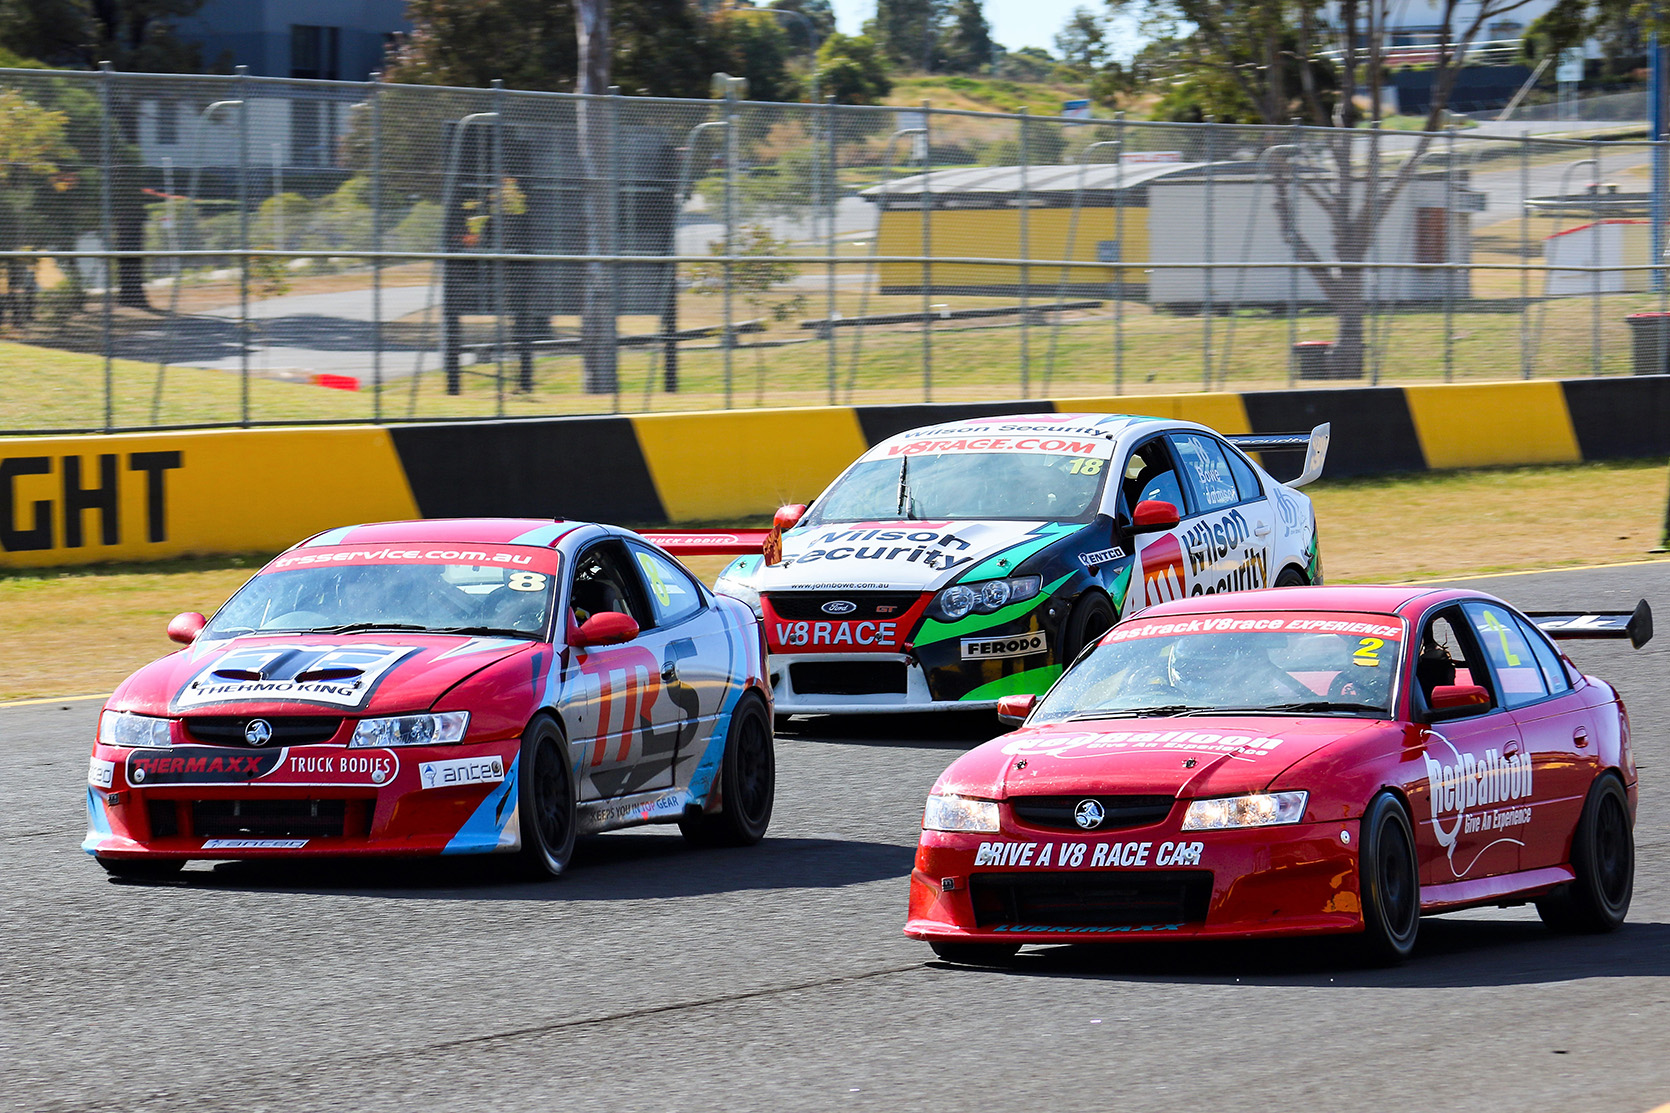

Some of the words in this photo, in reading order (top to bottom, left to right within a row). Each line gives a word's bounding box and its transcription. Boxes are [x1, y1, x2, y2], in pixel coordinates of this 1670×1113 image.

[904, 426, 990, 438] Wilson
[998, 424, 1108, 436] Security
[887, 438, 1096, 456] V8RACE.COM
[1187, 437, 1211, 464] 18
[1069, 457, 1104, 475] 18
[1193, 466, 1221, 484] Bowe
[0, 450, 184, 552] GHT
[807, 529, 972, 551] Wilson
[1181, 508, 1250, 577] Wilson
[275, 548, 532, 568] trsservice.com.au
[768, 545, 974, 571] Security
[1079, 548, 1123, 565] RENTCO
[506, 572, 547, 592] 8
[638, 552, 671, 607] 8
[1191, 547, 1267, 597] urity
[791, 583, 889, 591] www.johnbowe.com.au
[876, 605, 898, 613] GT
[1104, 618, 1281, 643] fastrackV8race
[1284, 619, 1403, 638] EXPERIENCE
[1483, 610, 1522, 667] 2
[967, 635, 1041, 655] FERODO
[1352, 638, 1385, 658] 2
[197, 682, 294, 696] THERMO
[297, 683, 355, 697] KING
[1087, 742, 1128, 750] Give
[1134, 741, 1158, 749] An
[1164, 741, 1269, 756] Experience
[132, 757, 265, 774] THERMAXX
[291, 756, 334, 772] TRUCK
[340, 756, 391, 773] BODIES
[1423, 748, 1533, 819] RedBalloon
[591, 807, 615, 821] KEEPS
[615, 804, 631, 817] YOU
[632, 803, 641, 814] IN
[640, 801, 655, 812] TOP
[656, 796, 679, 809] GEAR
[1464, 814, 1480, 834] Give
[1481, 811, 1492, 831] An
[1492, 806, 1532, 832] Experience
[974, 842, 1038, 866] DRIVE
[1035, 842, 1054, 867] A
[1058, 842, 1087, 867] V8
[1090, 842, 1152, 867] RACE
[1155, 841, 1204, 866] CAR
[993, 922, 1187, 932] LUBRIMAXX
